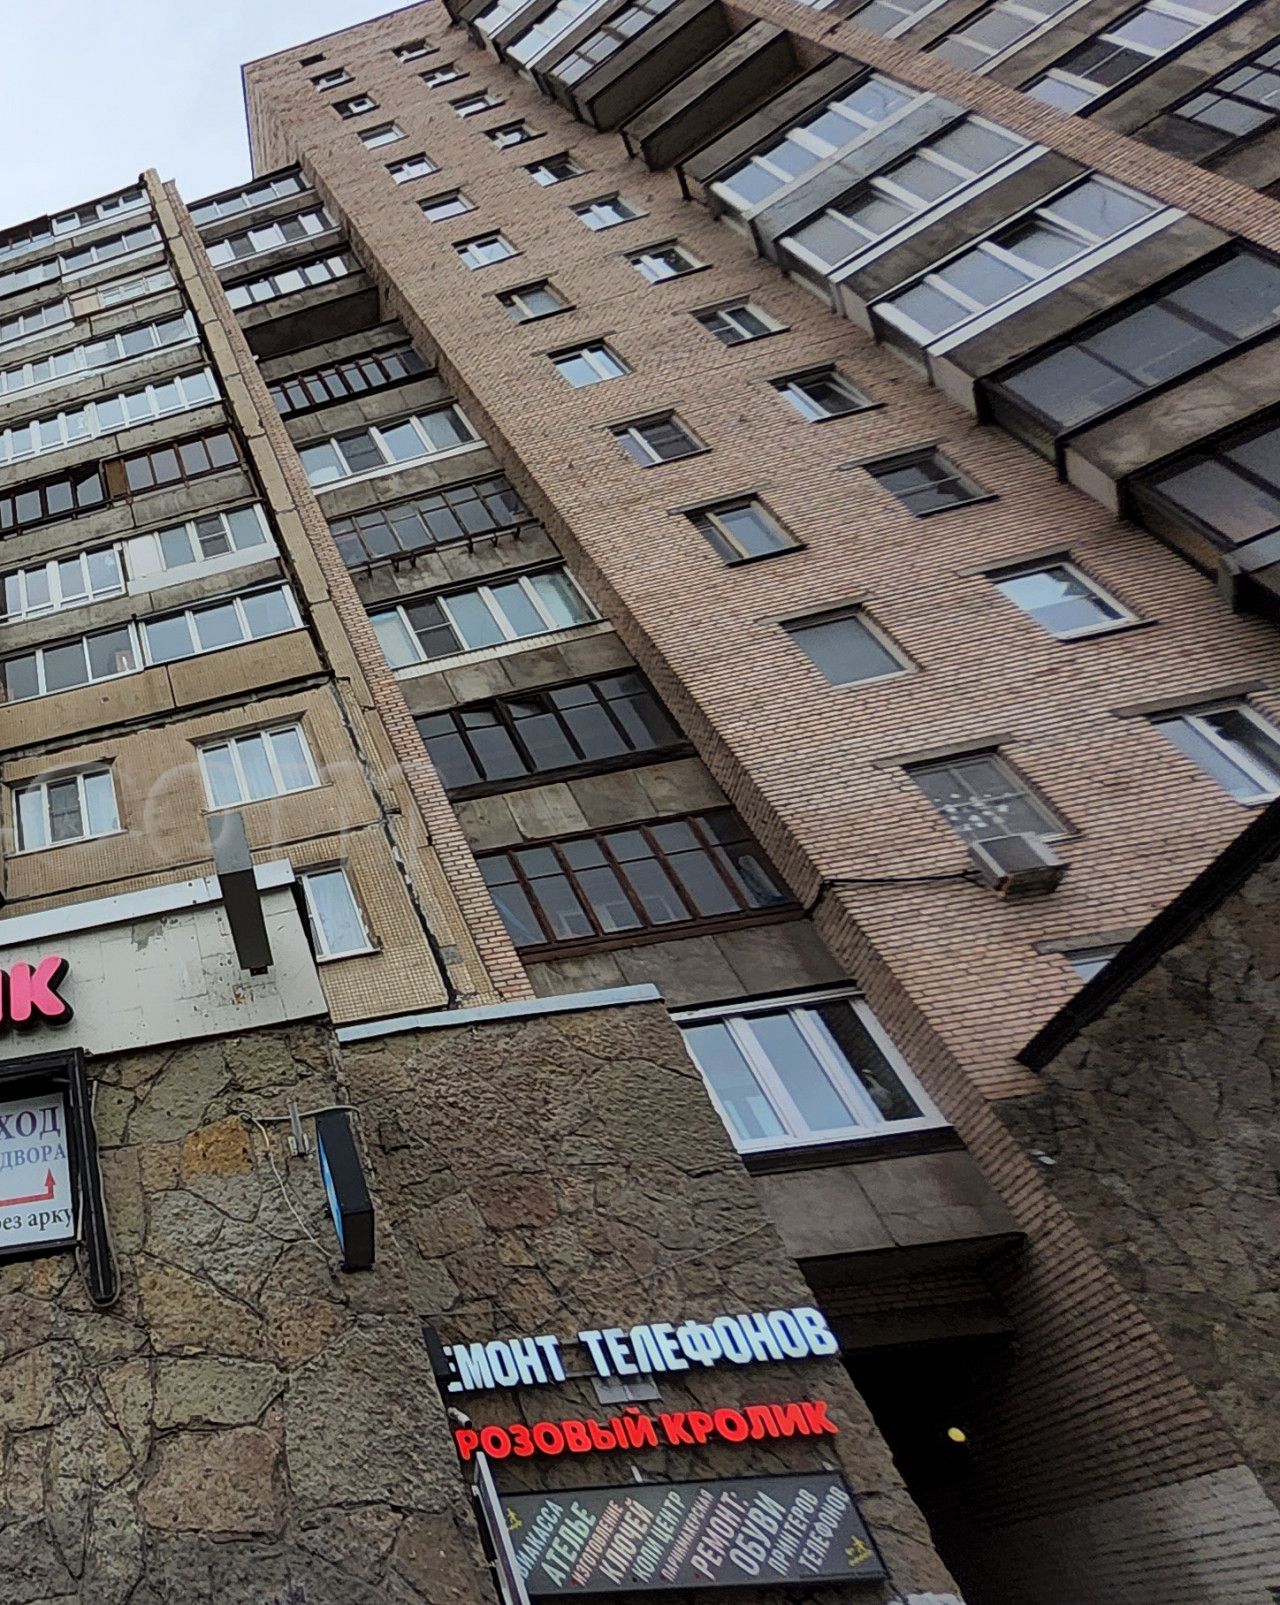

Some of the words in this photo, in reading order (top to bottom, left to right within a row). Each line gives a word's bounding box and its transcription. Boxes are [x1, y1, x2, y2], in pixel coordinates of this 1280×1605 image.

[0, 1143, 66, 1172] ДВОРА
[27, 1208, 72, 1231] арку
[577, 1307, 839, 1378] ТЕЛЕФОНОВ
[454, 1407, 658, 1460] РОЗОВЫЙ
[659, 1400, 840, 1446] КРОЛИК
[540, 1500, 597, 1588] АТЕЛЬЕ
[599, 1496, 655, 1586] КЛЮЧЕЙ
[631, 1536, 665, 1584] КОПИ
[650, 1490, 687, 1546] ЦЕНТР
[729, 1489, 787, 1577] ОБУВИ
[767, 1487, 819, 1577] ПРИНТЕРОВ
[797, 1485, 851, 1575] ТЕЛЕФОНОВ
